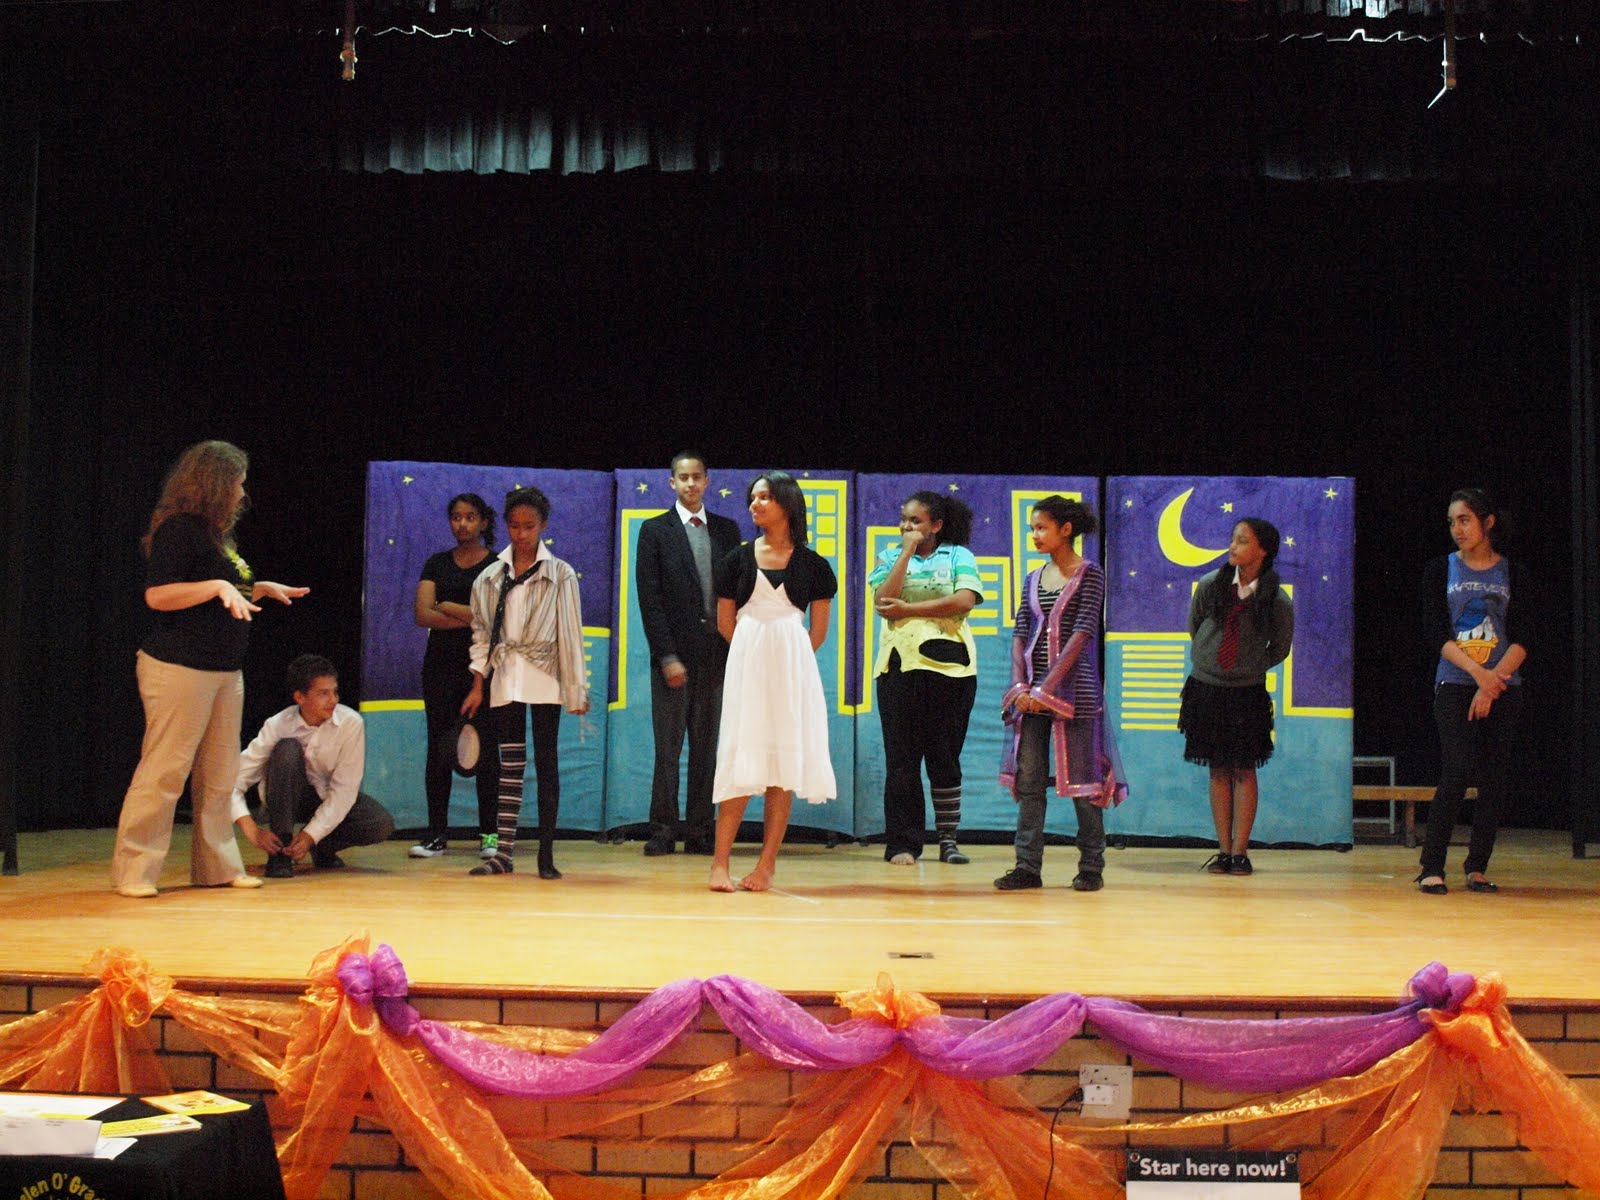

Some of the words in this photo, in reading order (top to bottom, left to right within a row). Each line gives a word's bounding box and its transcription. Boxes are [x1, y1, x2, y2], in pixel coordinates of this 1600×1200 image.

[1139, 1157, 1181, 1176] Star
[1186, 1157, 1230, 1176] here
[1236, 1159, 1286, 1177] now!
